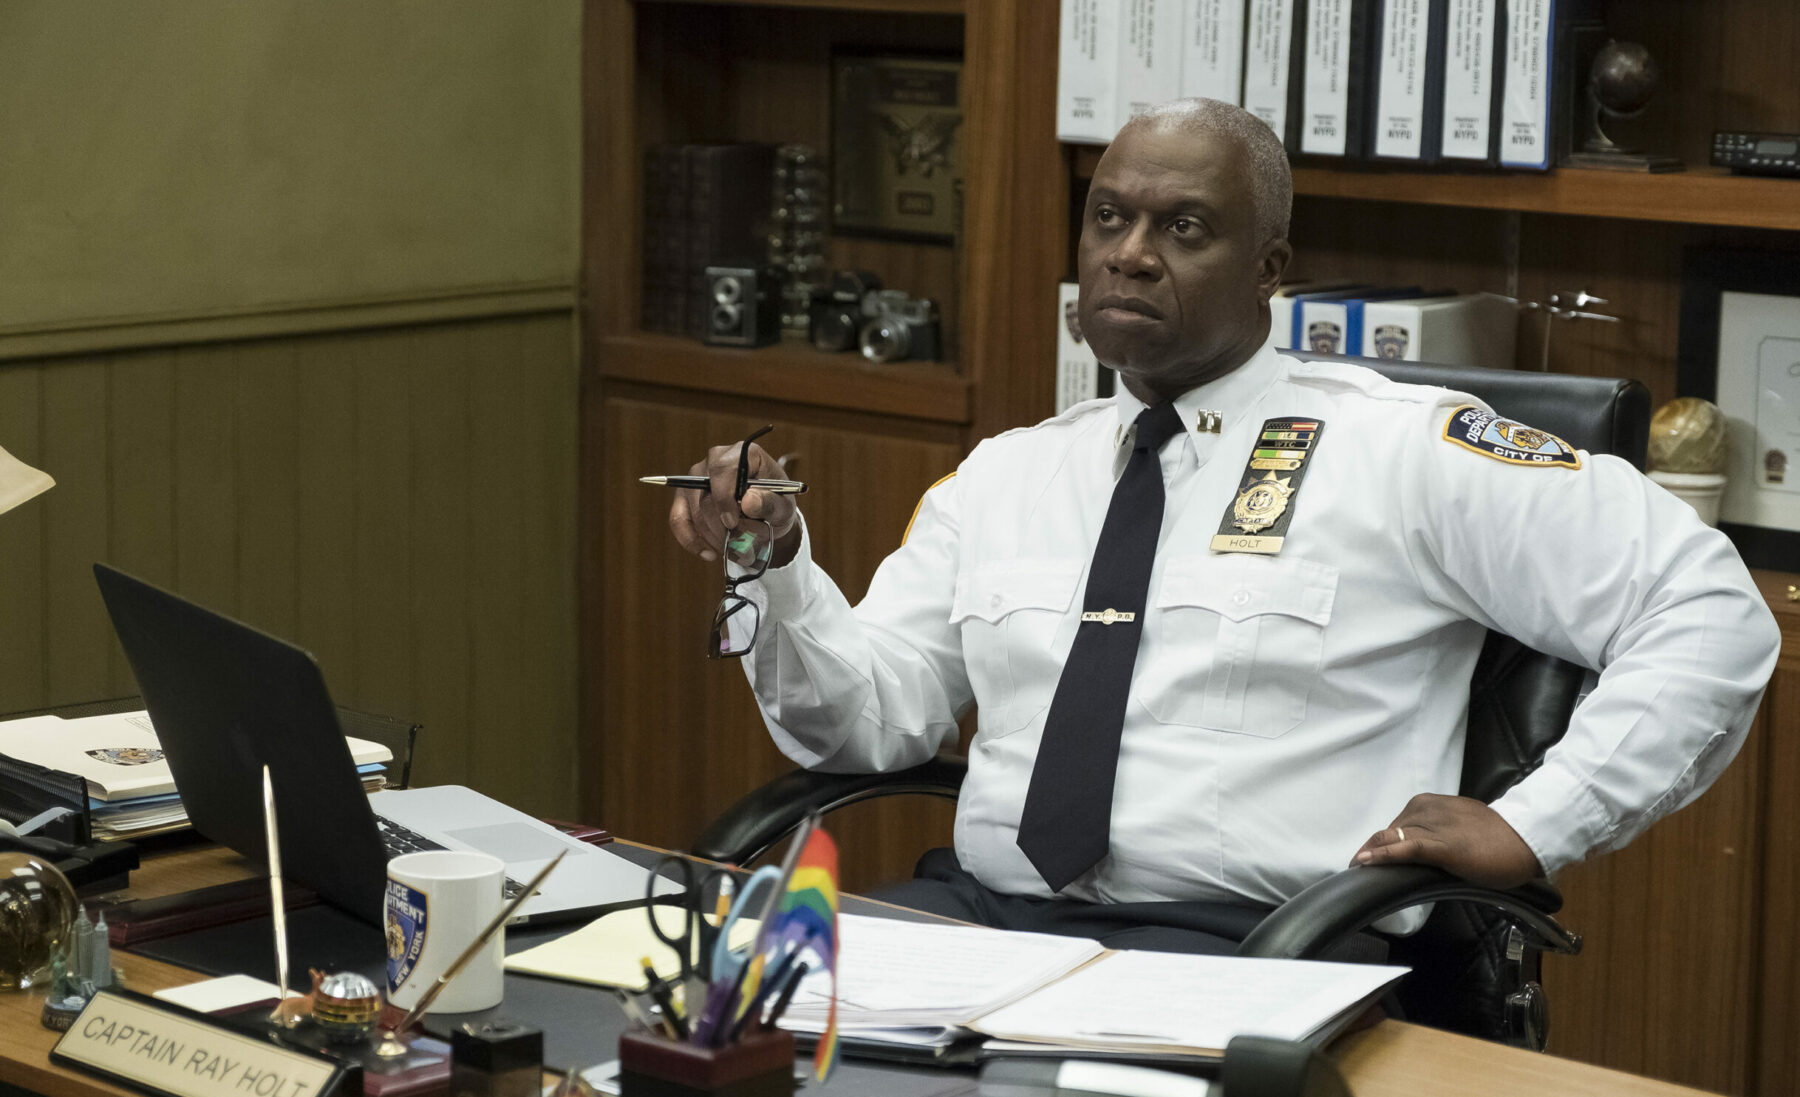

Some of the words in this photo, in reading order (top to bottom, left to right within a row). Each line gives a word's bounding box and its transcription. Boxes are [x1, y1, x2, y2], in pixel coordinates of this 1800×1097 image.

[1313, 126, 1336, 137] NYPD
[1388, 129, 1412, 140] NYPD
[1454, 129, 1478, 140] NYPD
[1511, 135, 1535, 146] NYPD
[1493, 446, 1528, 460] CITY
[1532, 454, 1553, 462] OF
[1229, 539, 1262, 548] HOLT
[387, 880, 408, 902] LICE
[407, 930, 425, 961] YORK
[83, 1016, 185, 1067] CAPTAIN
[183, 1048, 241, 1082] RAY
[235, 1066, 309, 1097] HOLT
